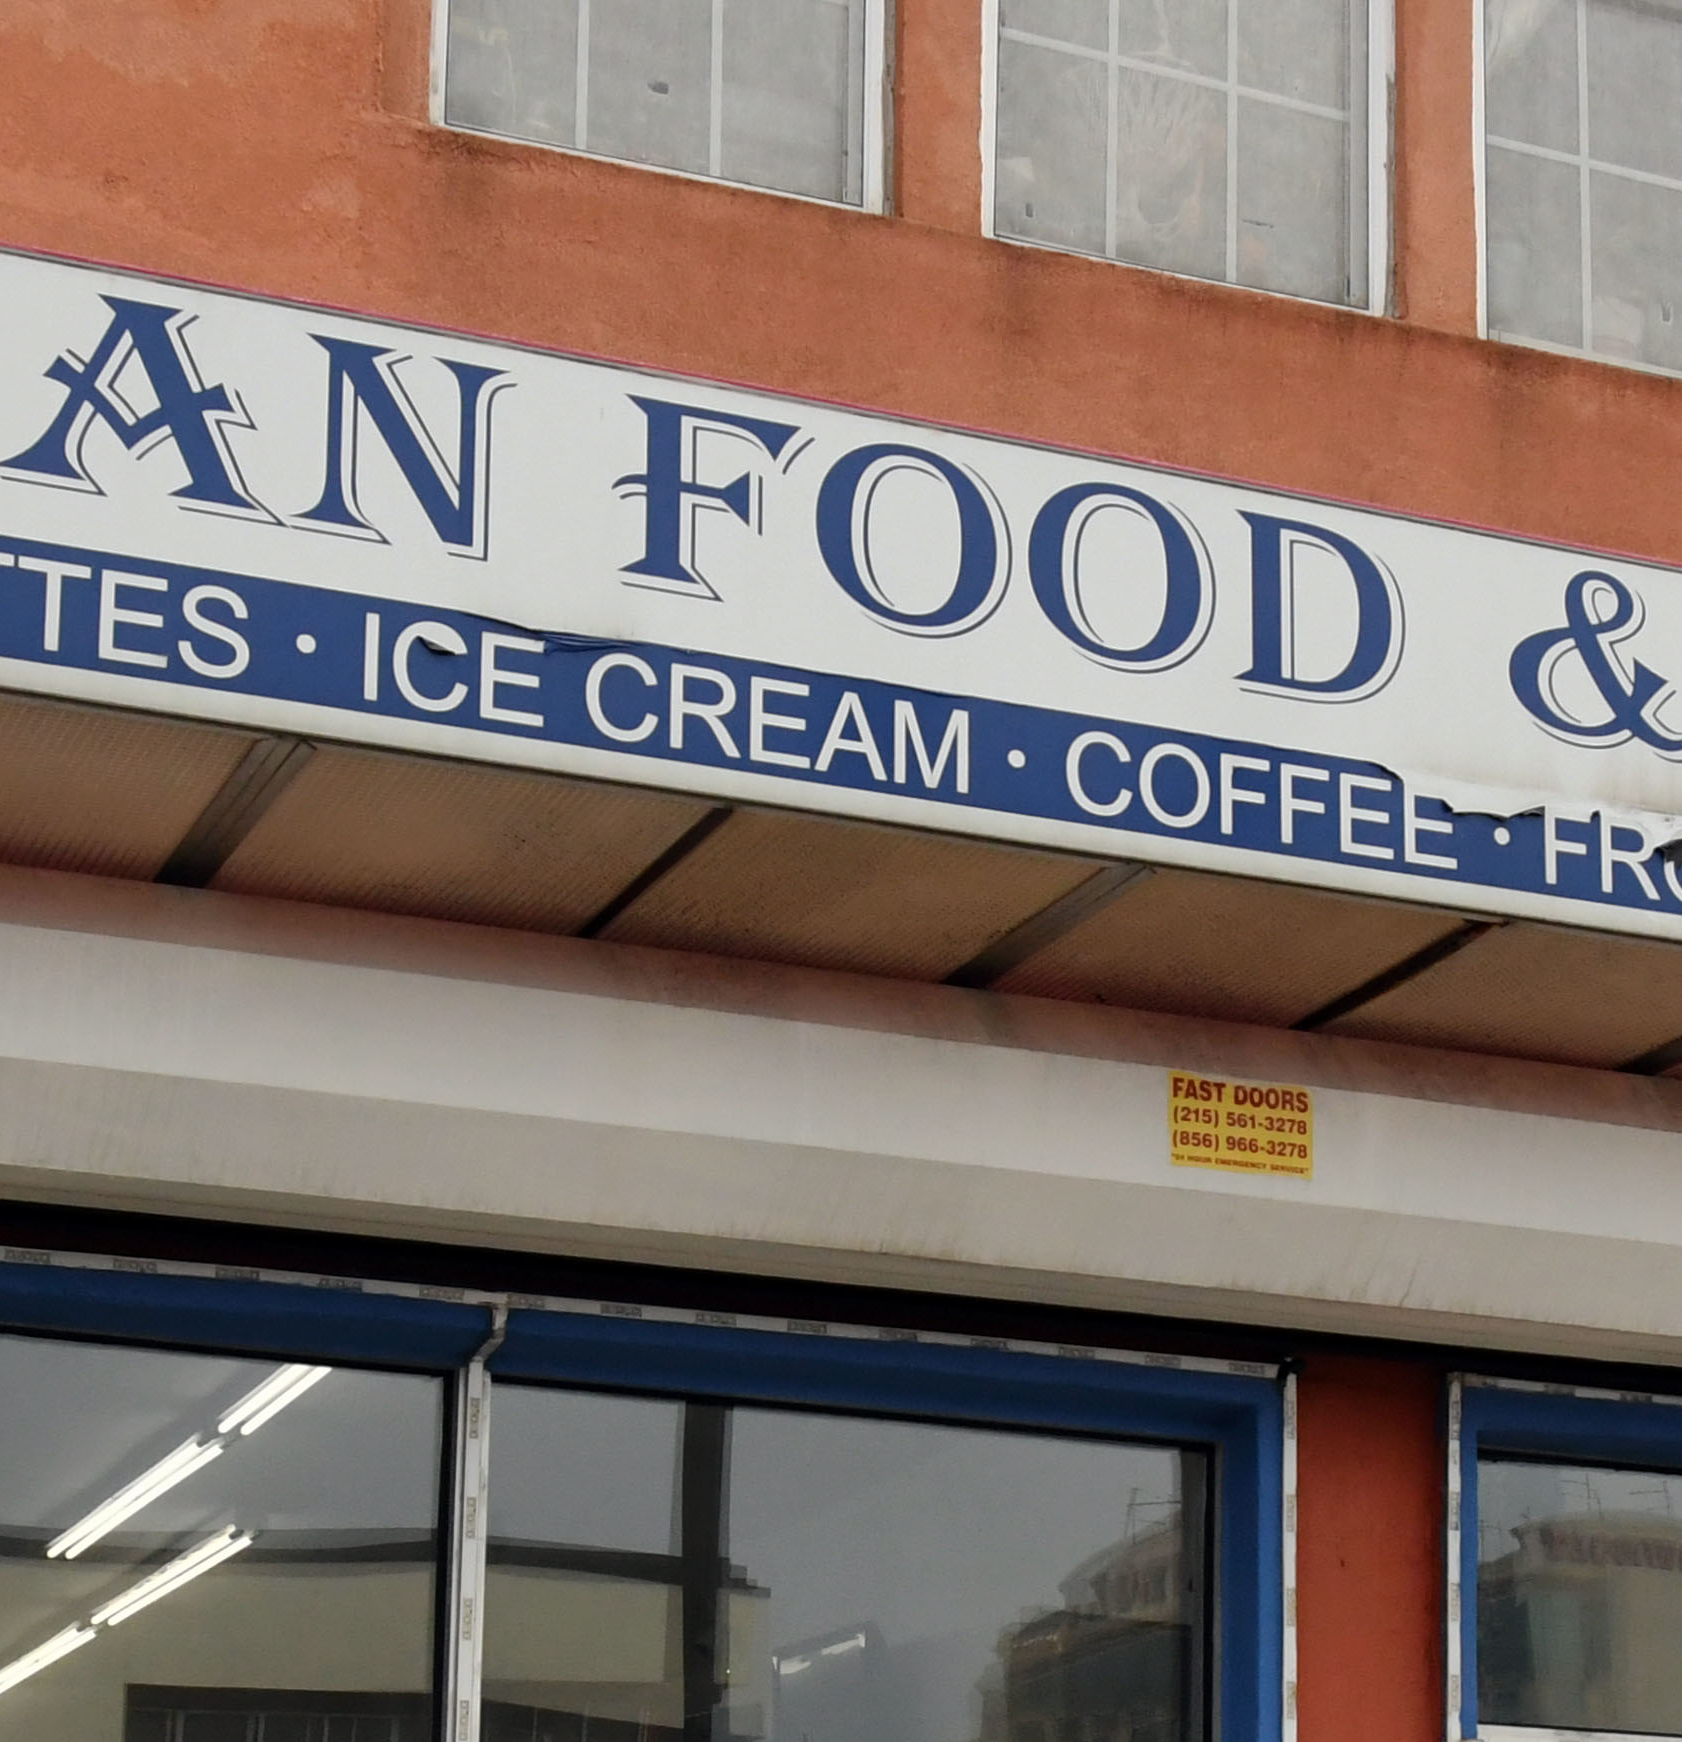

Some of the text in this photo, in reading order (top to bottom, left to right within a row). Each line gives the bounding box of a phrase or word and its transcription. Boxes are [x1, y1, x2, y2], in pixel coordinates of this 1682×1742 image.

[612, 393, 1406, 704] FOOD
[362, 611, 547, 730] ICE
[584, 652, 970, 795] CREAM
[1064, 731, 1457, 871] COFFEE
[1172, 1076, 1309, 1113] FAST DOORS
[1173, 1105, 1308, 1135] (215) 561-3278
[1172, 1129, 1308, 1159] (856) 966-3278
